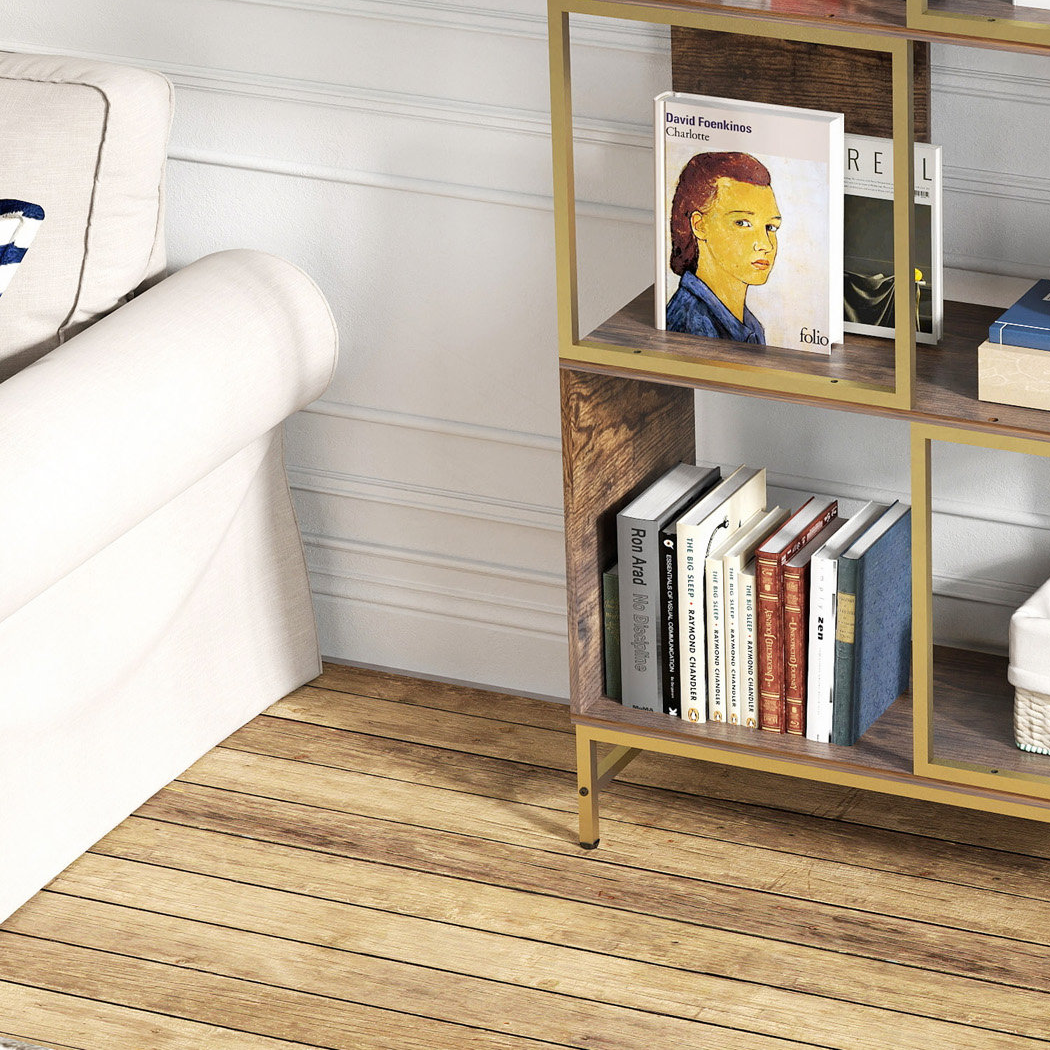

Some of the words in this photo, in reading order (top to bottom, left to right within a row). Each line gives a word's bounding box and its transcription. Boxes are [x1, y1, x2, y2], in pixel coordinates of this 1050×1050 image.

[665, 126, 710, 142] Charlotte
[666, 112, 696, 127] David
[698, 116, 752, 134] Foenkinos
[799, 327, 829, 347] folio
[631, 527, 647, 553] Ron
[686, 537, 694, 553] THE
[631, 556, 647, 586] Arad
[665, 554, 674, 590] ESSENTIALS
[686, 556, 694, 571] BIG
[666, 590, 674, 600] OF
[687, 574, 695, 598] SLEEP
[632, 593, 650, 611] No
[667, 600, 675, 621] VISUAL
[631, 614, 651, 673] Discipline
[688, 609, 696, 654] RAYMOND
[667, 621, 676, 673] COMMUNICATION
[713, 629, 721, 666] RAYMOND
[689, 656, 697, 701] CHANDLER
